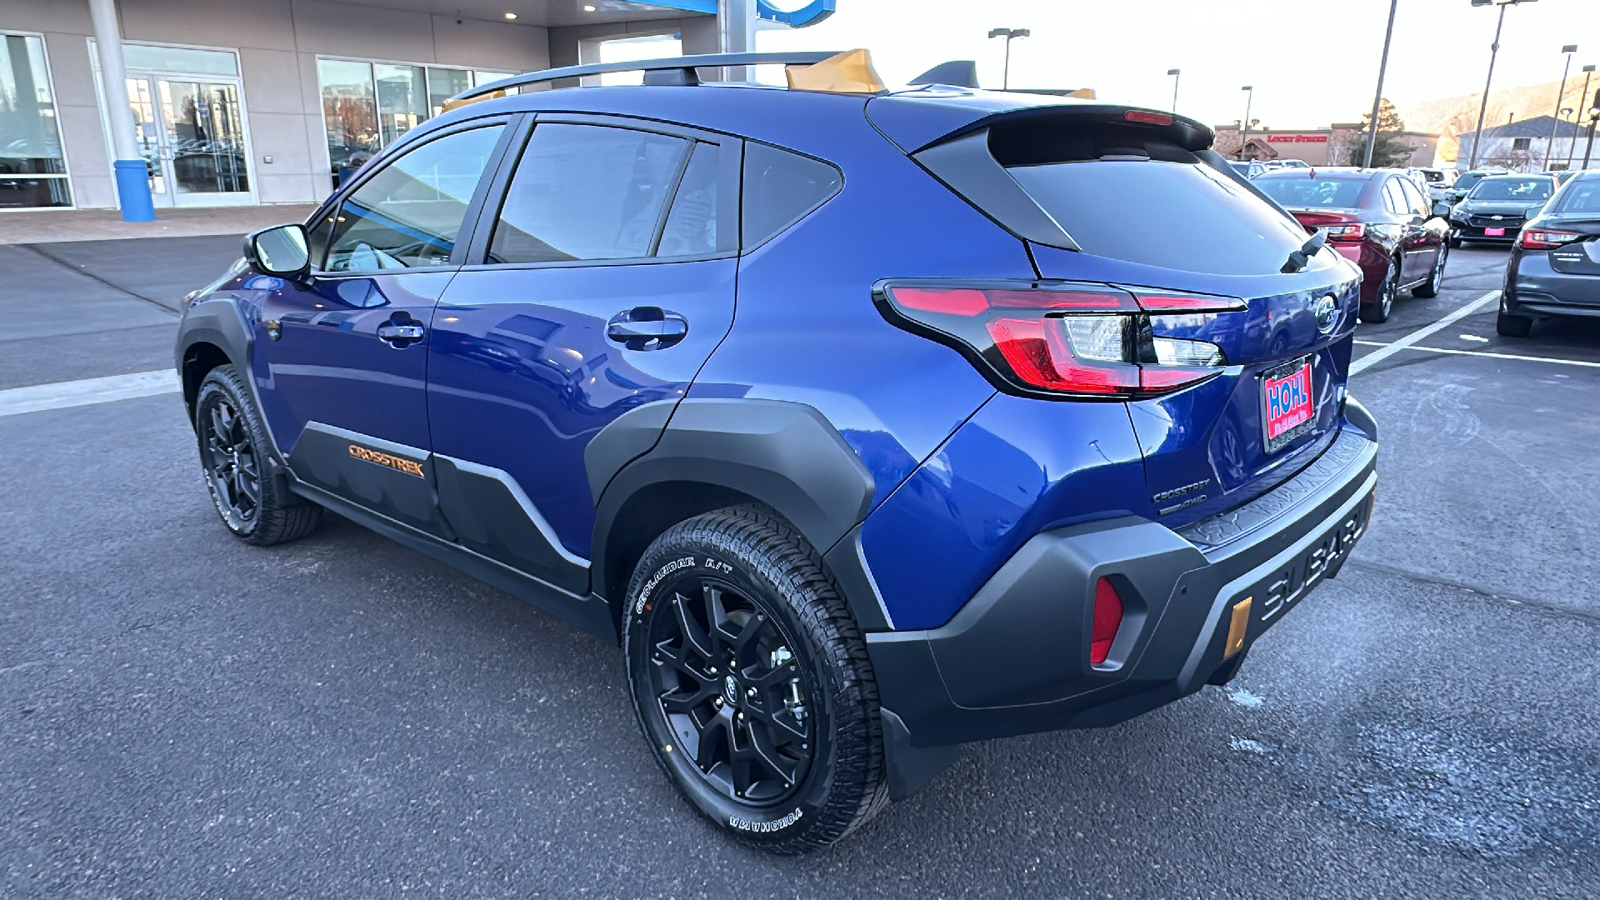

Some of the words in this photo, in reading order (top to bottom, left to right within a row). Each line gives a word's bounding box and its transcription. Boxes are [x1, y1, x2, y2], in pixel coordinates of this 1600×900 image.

[1267, 374, 1308, 422] HOHL
[347, 444, 425, 478] CROSSTREK
[1152, 478, 1210, 503] CROSSTREK
[1179, 494, 1208, 510] AWD
[1261, 507, 1365, 621] SUBARU
[635, 556, 696, 614] GEOLANDAR
[704, 557, 734, 574] A/T
[729, 806, 804, 833] YOKOHAMA
